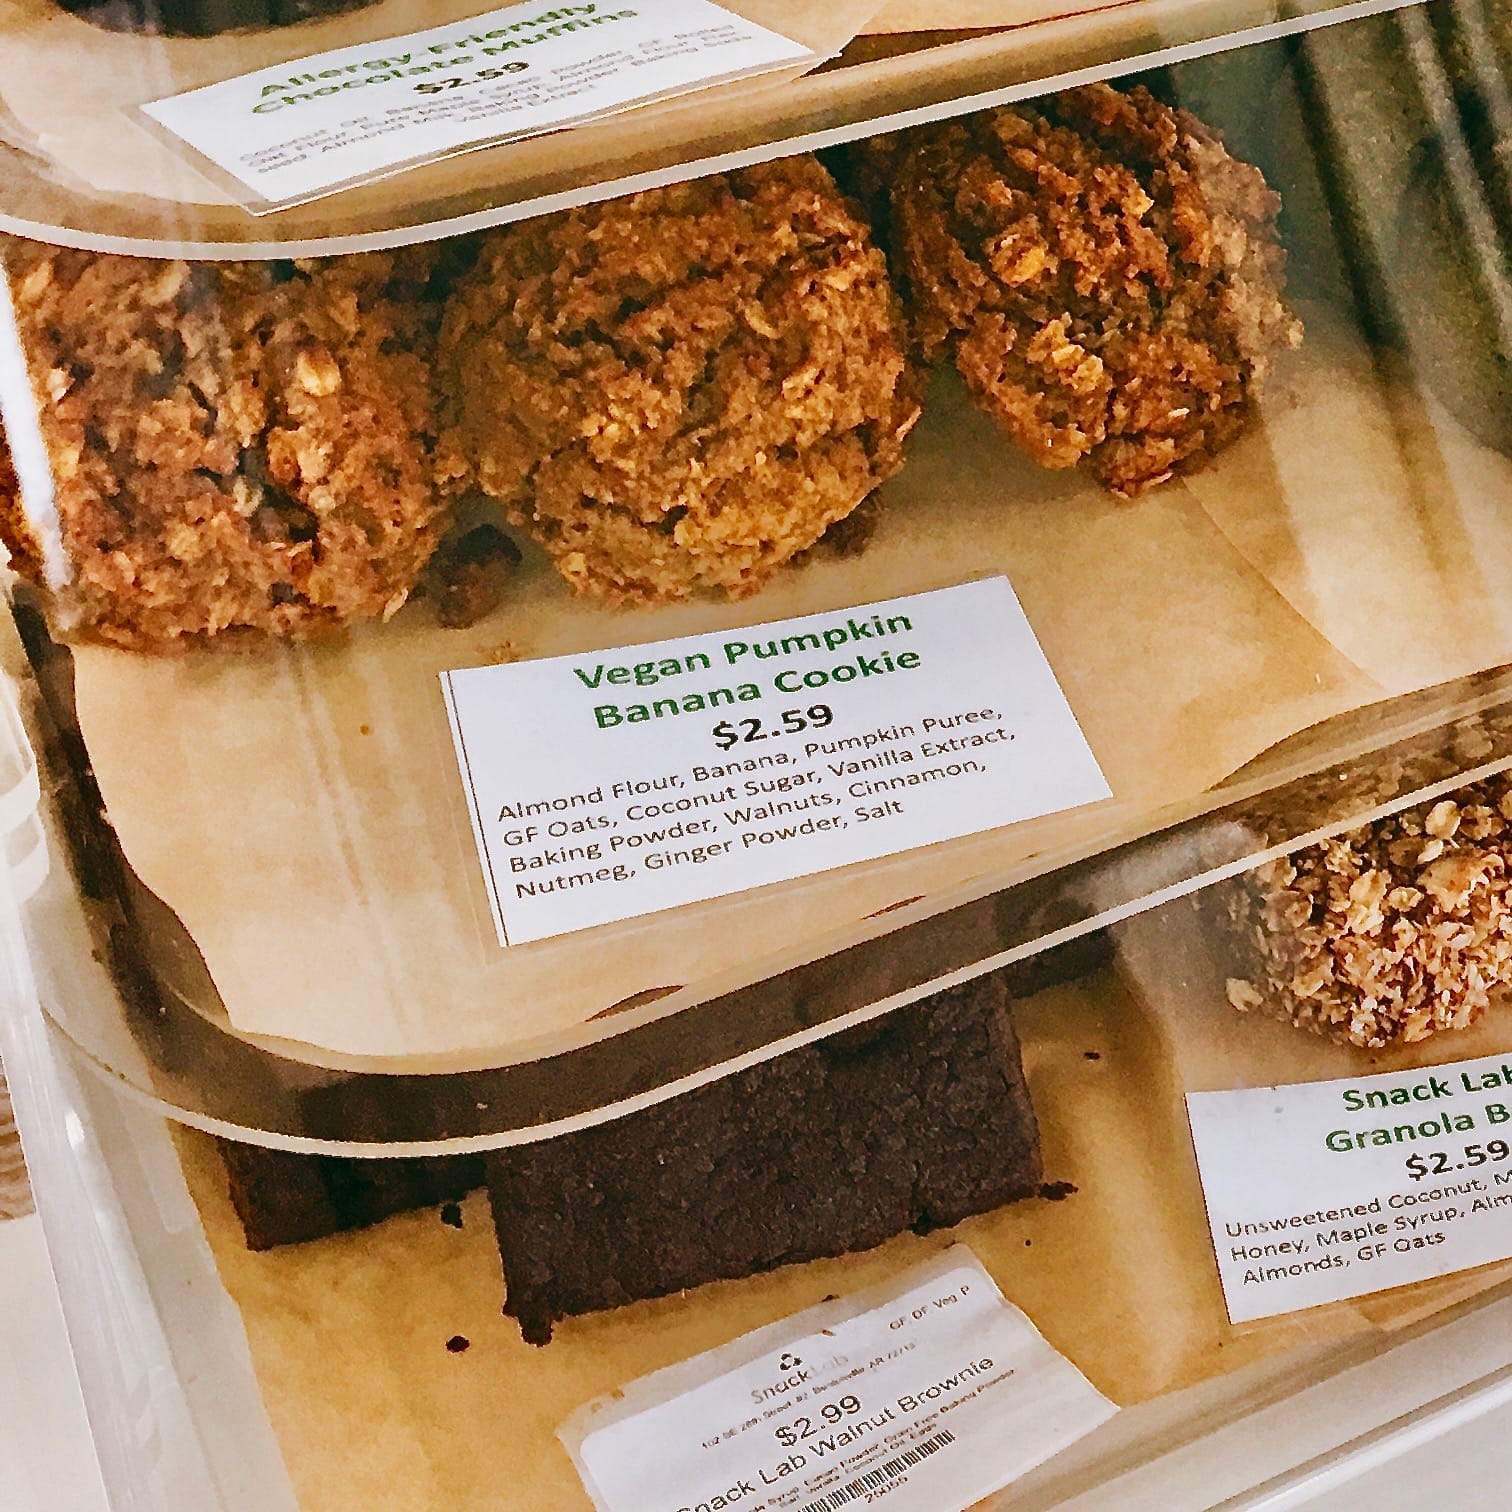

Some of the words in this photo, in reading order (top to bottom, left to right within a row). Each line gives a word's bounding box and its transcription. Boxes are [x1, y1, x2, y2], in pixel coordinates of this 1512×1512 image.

[252, 55, 474, 113] Chocolate
[482, 9, 638, 56] Muffins
[261, 54, 411, 96] Allergy
[427, 4, 596, 54] Friendly
[413, 61, 529, 93] $2.59
[573, 652, 710, 691] Vegan
[724, 612, 913, 665] Pumpkin
[594, 682, 762, 730] Banana
[773, 648, 921, 694] Cookie
[712, 704, 834, 749] $2.59
[498, 788, 602, 822] Almond
[612, 774, 685, 801] Flour,
[692, 750, 795, 784] Banana,
[805, 721, 916, 760] Pumpkin
[923, 707, 1002, 734] Puree,
[503, 827, 538, 847] GF
[548, 813, 618, 840] Oats,
[626, 787, 736, 823] Coconut
[744, 768, 823, 797] Sugar,
[828, 749, 914, 777] Vanilla
[921, 727, 1014, 757] Extract,
[510, 838, 601, 874] Baking
[609, 819, 717, 854] Powder,
[724, 793, 839, 825] Walnuts,
[848, 761, 986, 799] Cinnamon,
[516, 864, 636, 900] Nutmeg,
[644, 839, 732, 873] Ginger
[742, 813, 848, 849] Powder,
[857, 799, 902, 823] Salt
[1342, 1076, 1449, 1111] Snack
[1325, 1110, 1474, 1152] Granola
[1406, 1139, 1510, 1181] $2.59
[1224, 1198, 1381, 1237] Unsweetened
[1230, 1234, 1310, 1262] Honey,
[1316, 1221, 1388, 1250] Maple
[1242, 1252, 1350, 1284] Almonds,
[1357, 1243, 1388, 1261] GF
[1394, 1230, 1445, 1253] Oats
[758, 1453, 806, 1486] Lab
[810, 1406, 897, 1459] Walnut
[897, 1358, 993, 1413] Brownie
[774, 1394, 861, 1447] $2.99
